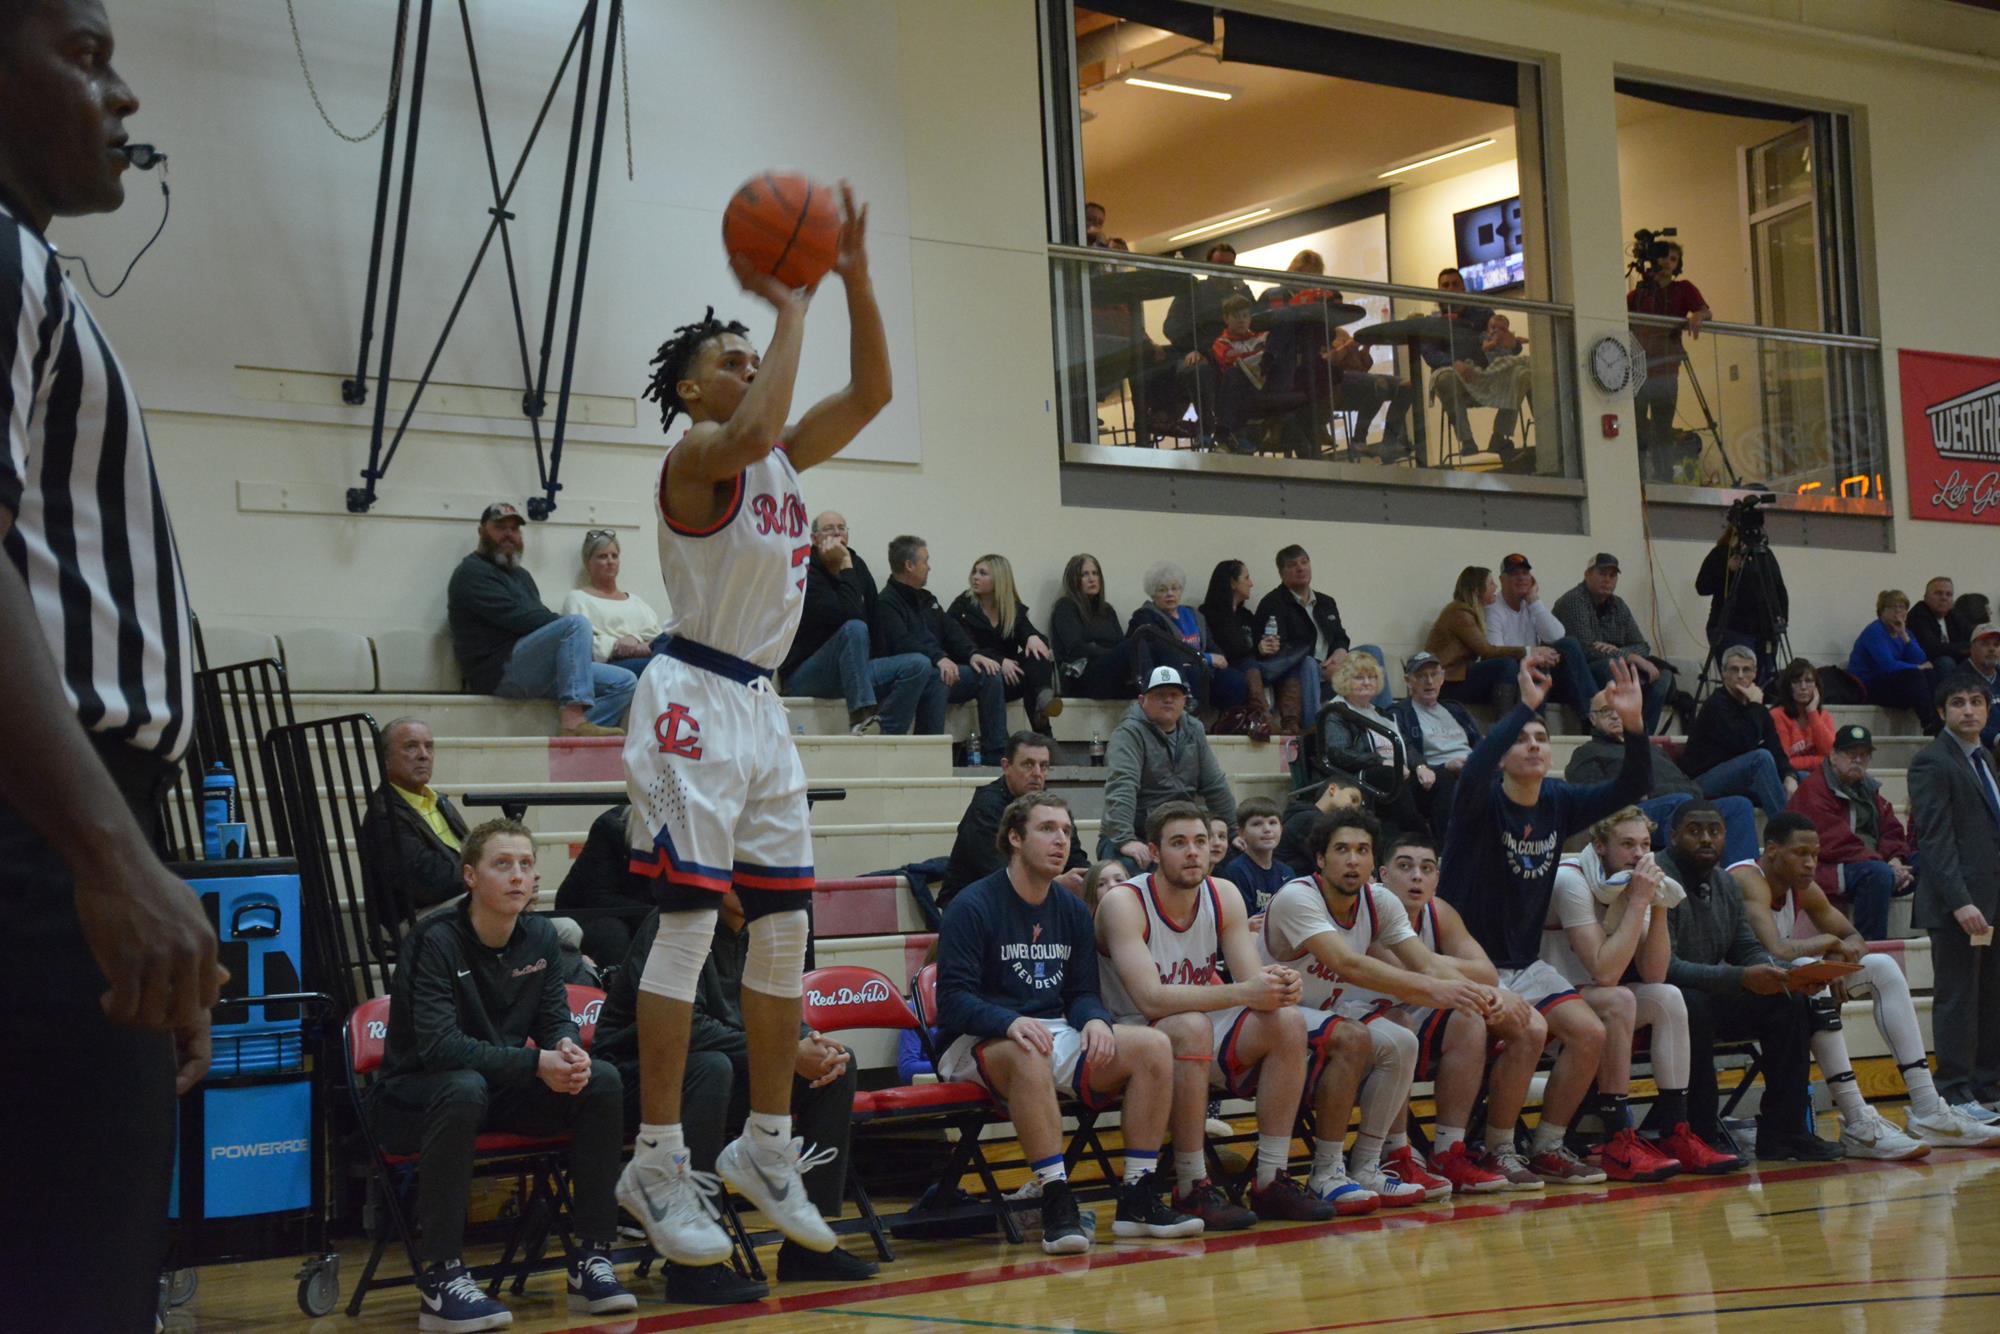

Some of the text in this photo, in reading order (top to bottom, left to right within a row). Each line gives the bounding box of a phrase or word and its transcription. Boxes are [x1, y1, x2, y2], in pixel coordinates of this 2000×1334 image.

[1012, 961, 1033, 985] RED
[806, 979, 890, 1006] Red Devils
[211, 1139, 308, 1161] POWERADE
